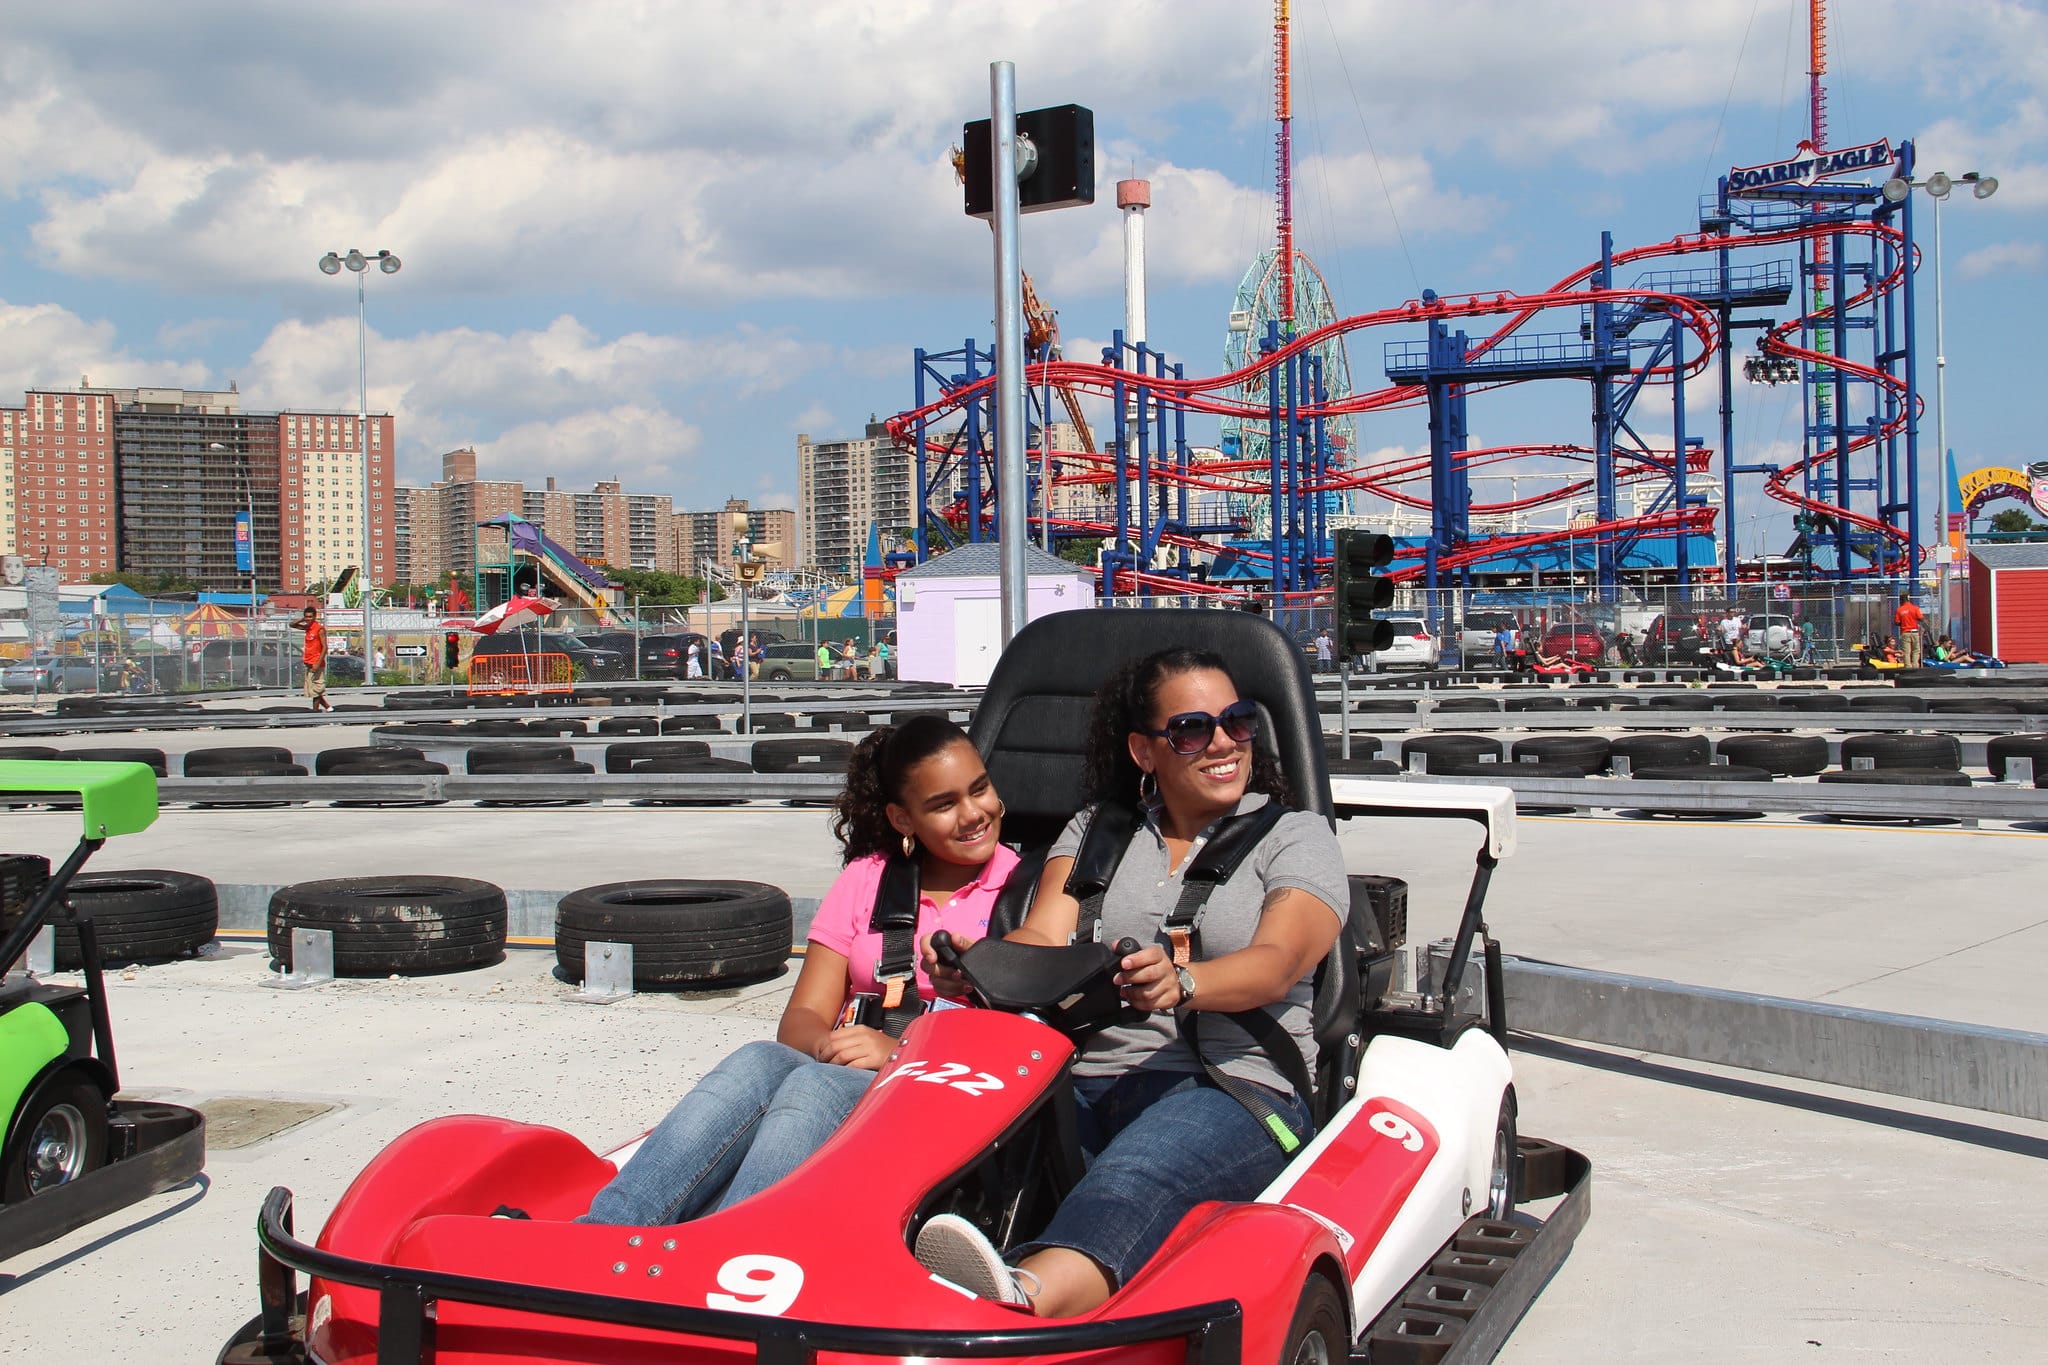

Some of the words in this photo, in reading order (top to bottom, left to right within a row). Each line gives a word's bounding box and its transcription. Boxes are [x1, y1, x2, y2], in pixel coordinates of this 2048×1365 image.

[1815, 144, 1889, 175] EAGLE
[874, 1060, 1005, 1097] F-22
[1368, 1111, 1424, 1152] 9
[706, 1254, 805, 1317] 9
